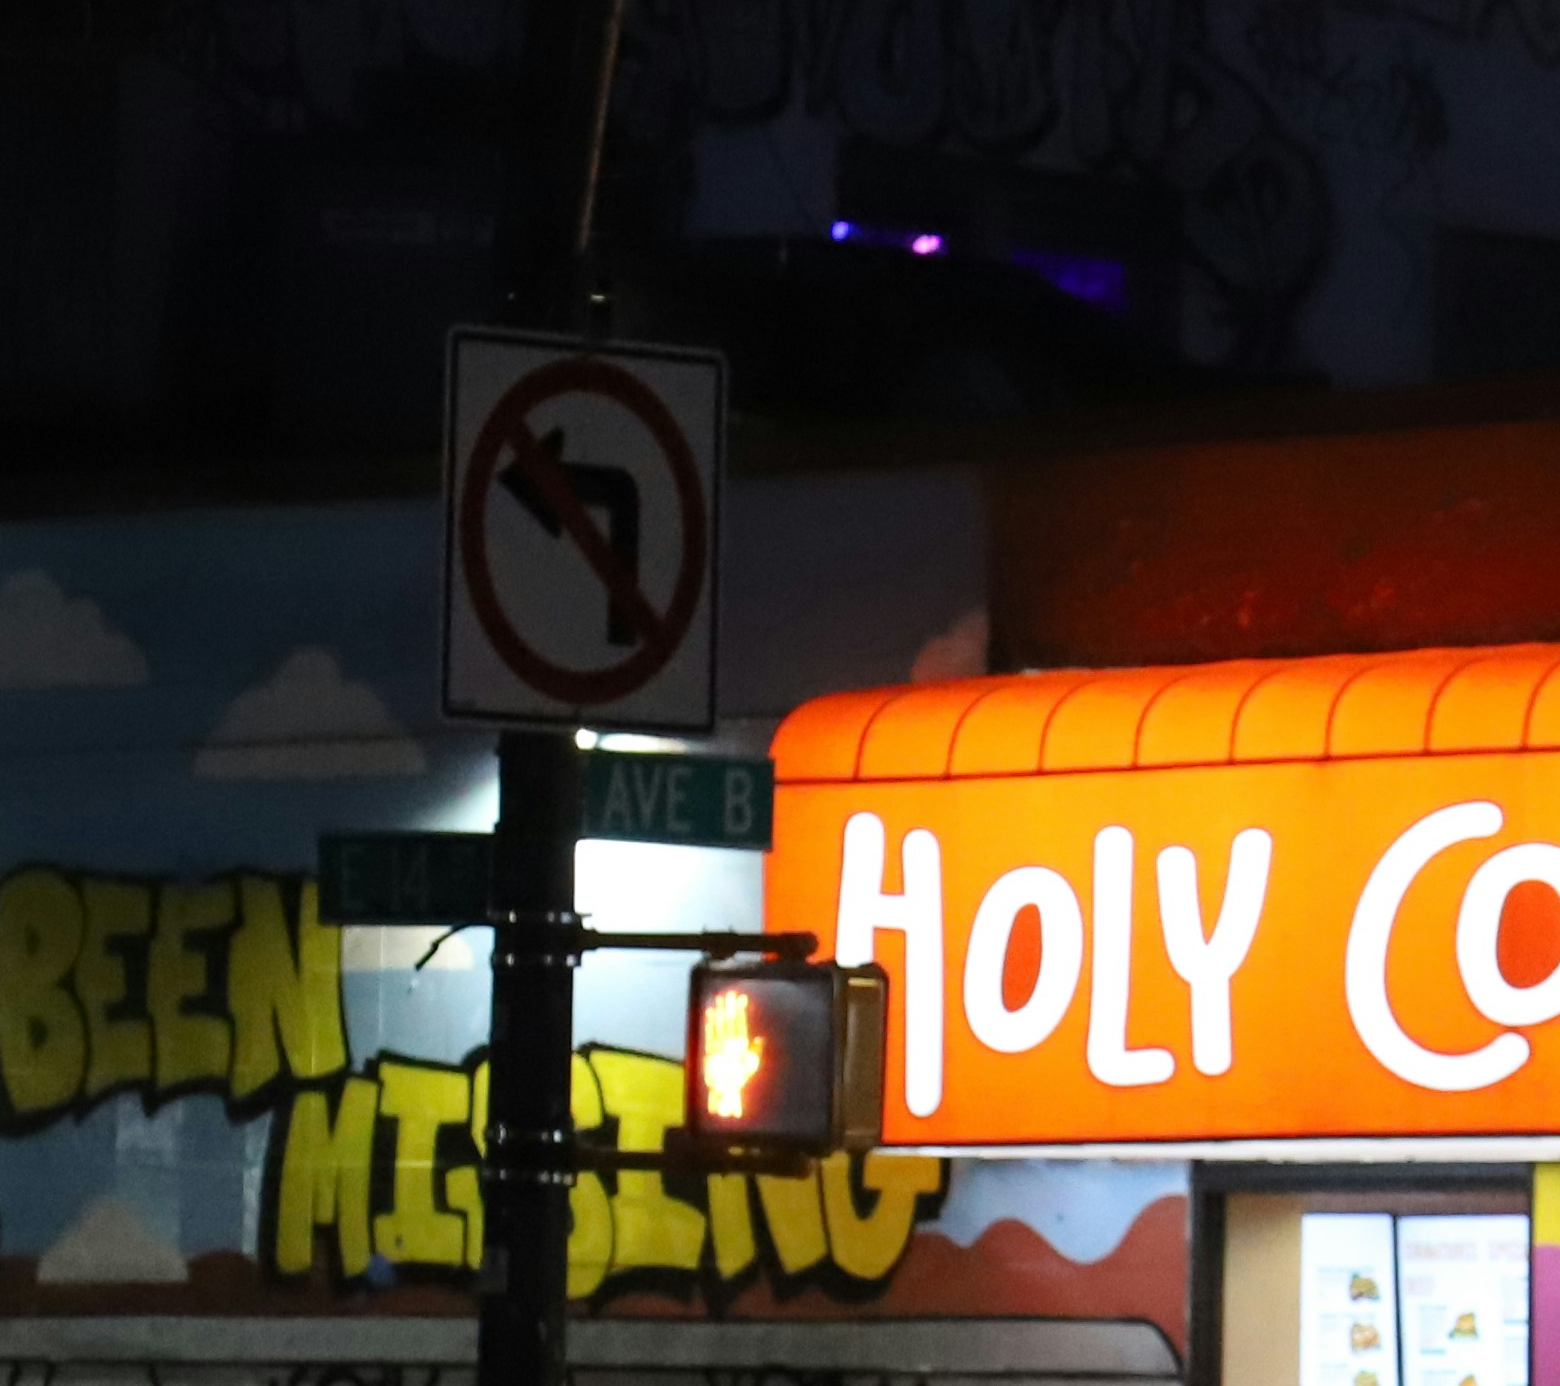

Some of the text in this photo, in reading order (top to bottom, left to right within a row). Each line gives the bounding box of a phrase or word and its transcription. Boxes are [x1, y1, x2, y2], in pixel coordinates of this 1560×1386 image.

[602, 759, 754, 835] AVE B
[340, 843, 365, 911] E
[390, 843, 430, 912] 14
[835, 812, 1272, 1118] HOLY
